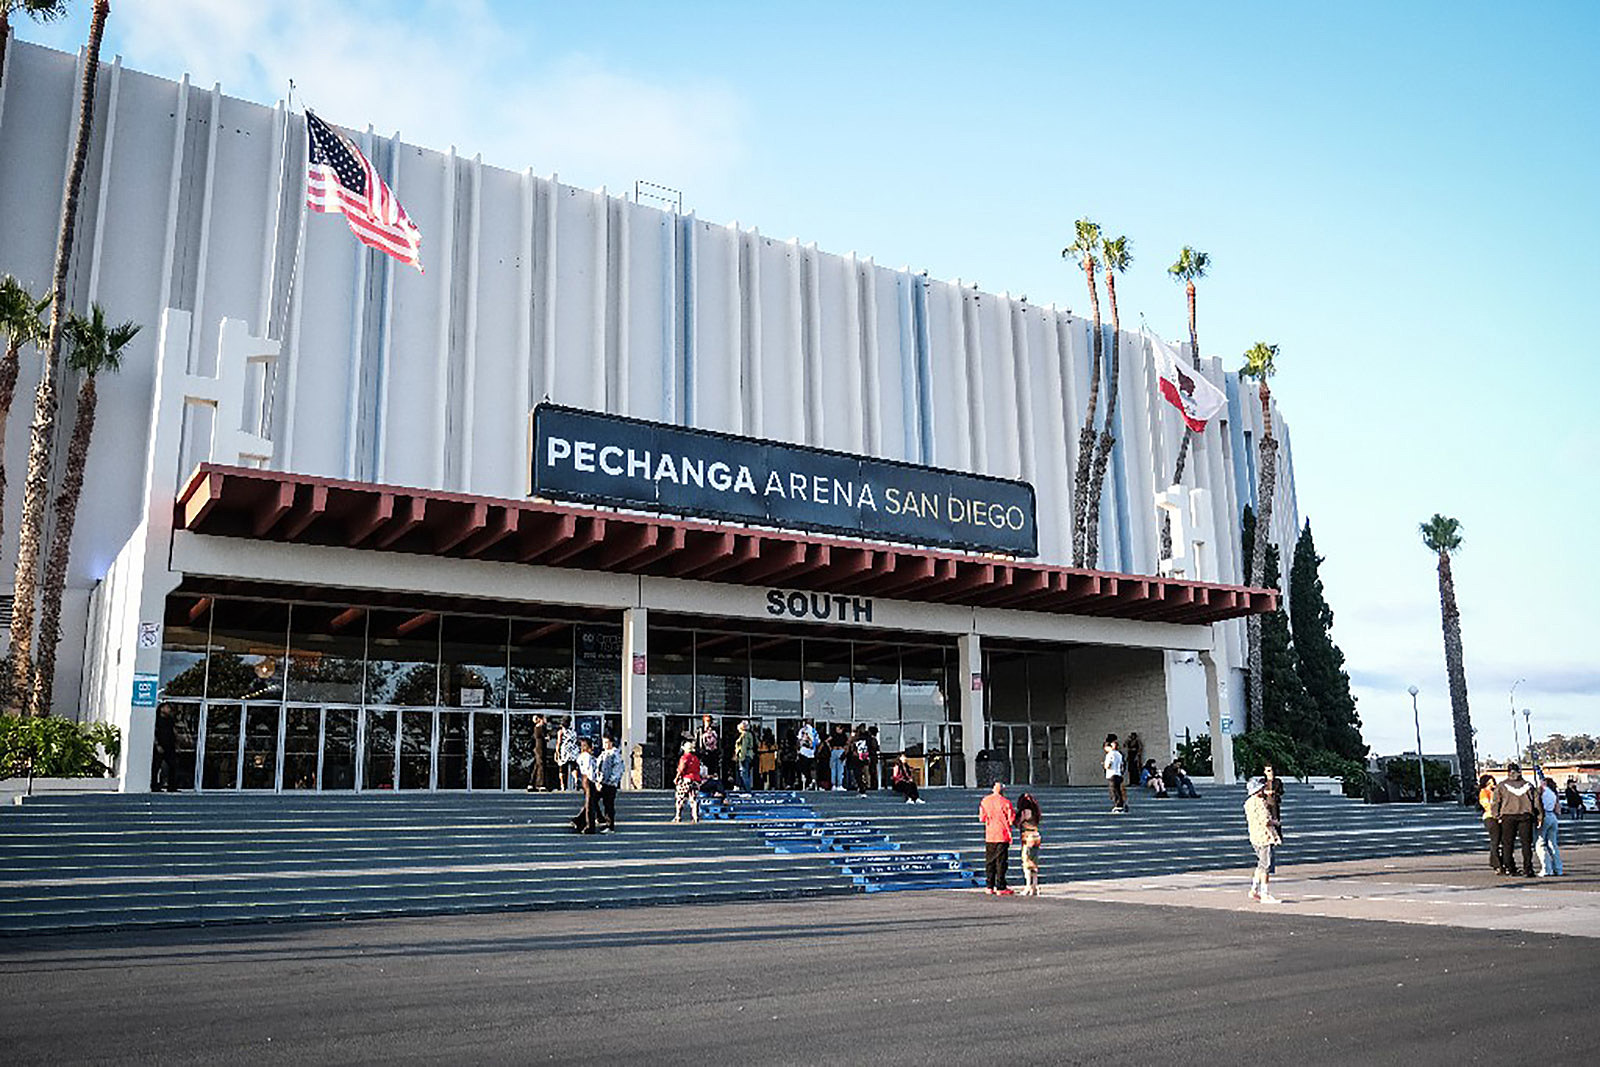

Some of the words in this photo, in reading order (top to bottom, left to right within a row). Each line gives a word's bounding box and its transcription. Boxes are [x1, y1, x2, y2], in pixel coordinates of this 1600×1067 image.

[547, 436, 758, 495] PECHANGA
[763, 470, 877, 512] ARENA
[885, 487, 939, 520] SAN
[947, 497, 1025, 531] DIEGO
[766, 589, 873, 623] SOUTH
